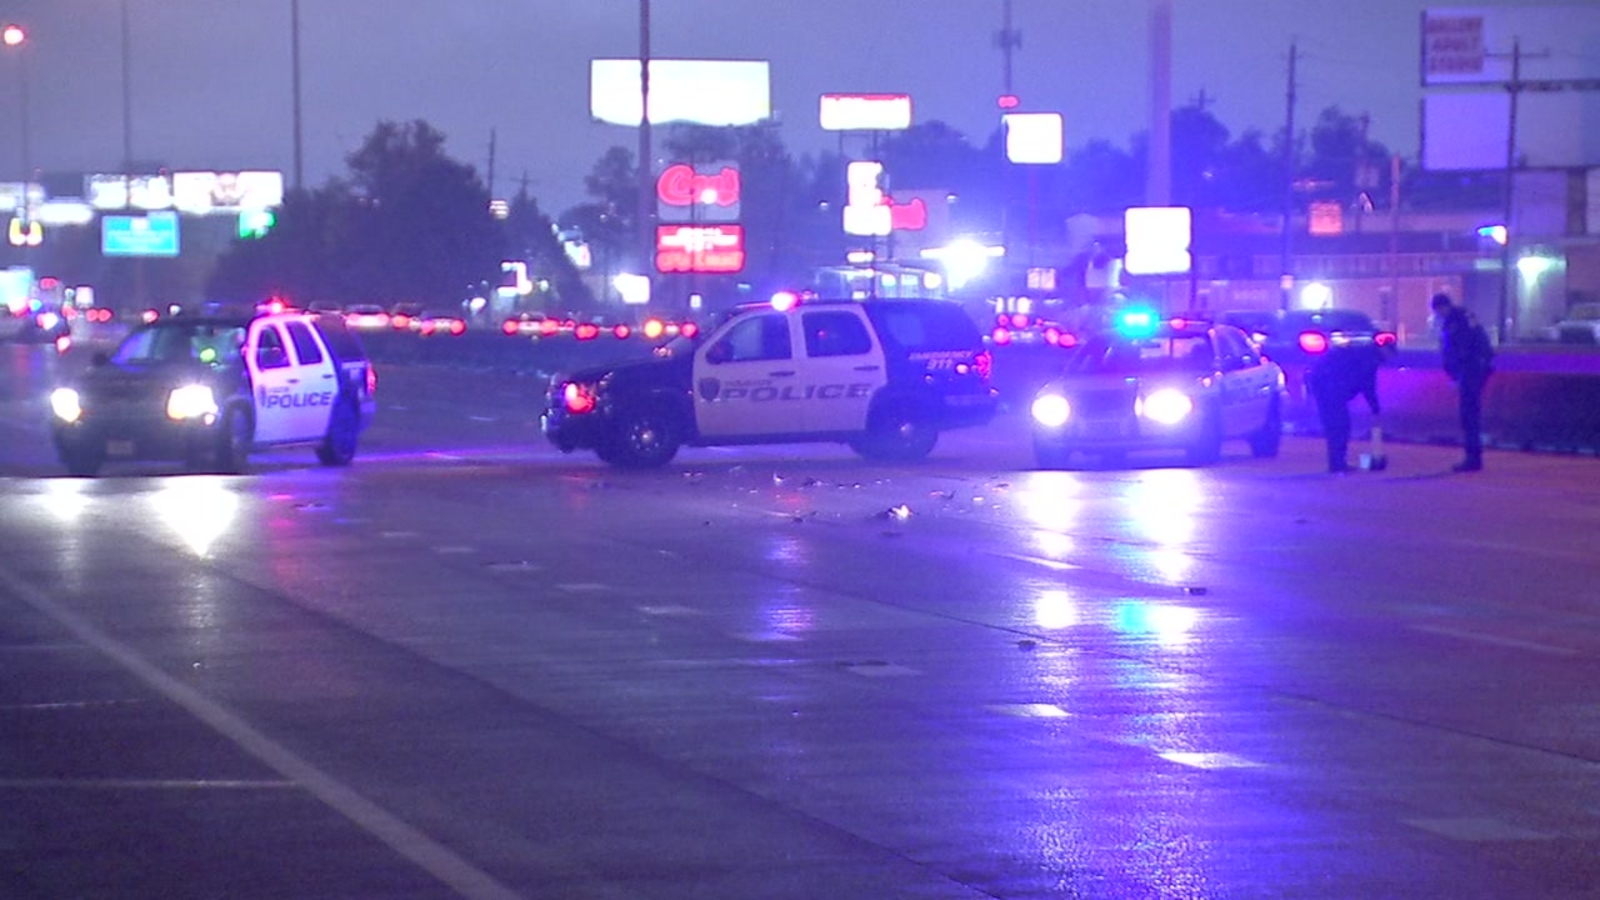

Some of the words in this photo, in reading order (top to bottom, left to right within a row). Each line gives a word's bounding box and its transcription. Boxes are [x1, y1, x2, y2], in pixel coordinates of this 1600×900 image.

[926, 359, 953, 370] 911
[267, 391, 332, 409] POLICE
[722, 383, 873, 401] POLICE
